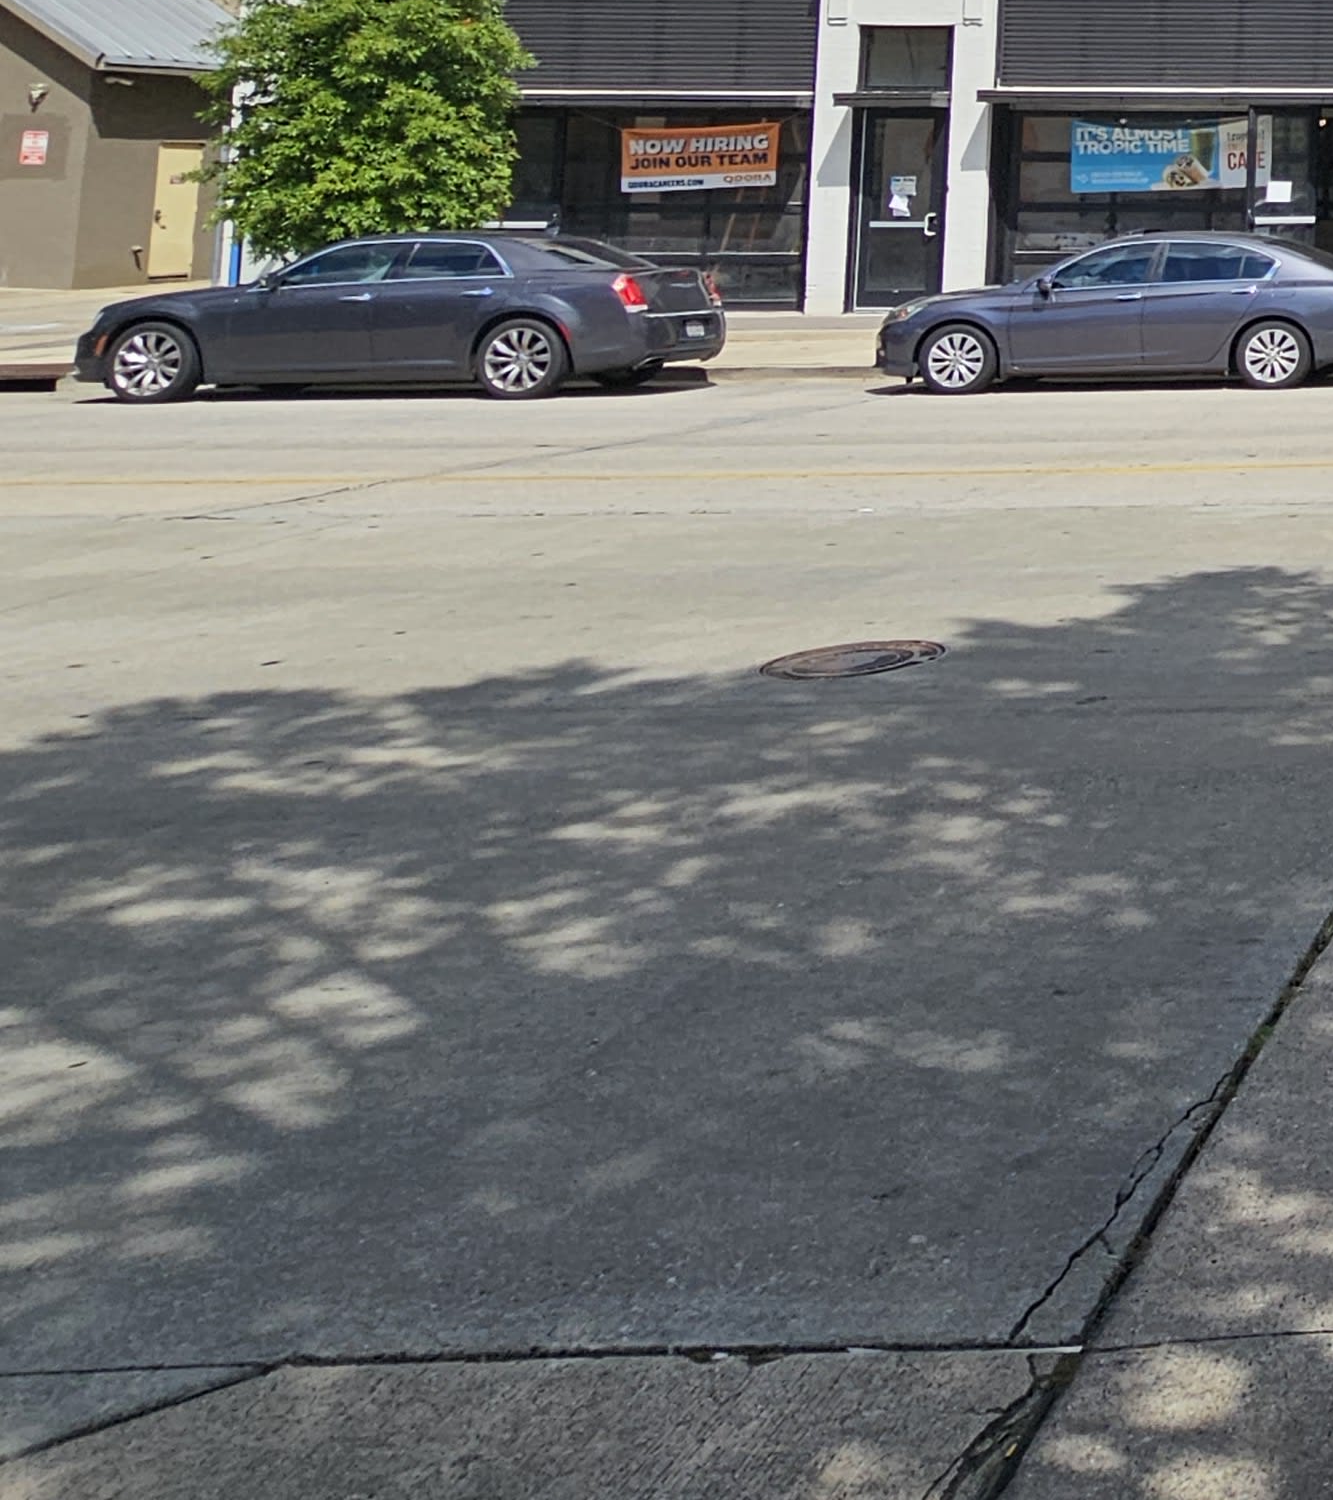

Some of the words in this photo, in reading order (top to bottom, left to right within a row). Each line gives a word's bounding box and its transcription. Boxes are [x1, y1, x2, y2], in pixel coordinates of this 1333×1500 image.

[1076, 127, 1107, 141] IT'S
[1111, 127, 1183, 141] ALMOST
[629, 138, 685, 155] NOW
[690, 133, 769, 153] HIRING
[1076, 140, 1142, 155] TROPIC
[1148, 139, 1190, 154] TIME
[630, 156, 671, 170] JOIN
[675, 155, 712, 167] OUR
[716, 153, 768, 166] TEAM
[1227, 151, 1266, 170] CAE
[723, 174, 772, 184] QDOBA
